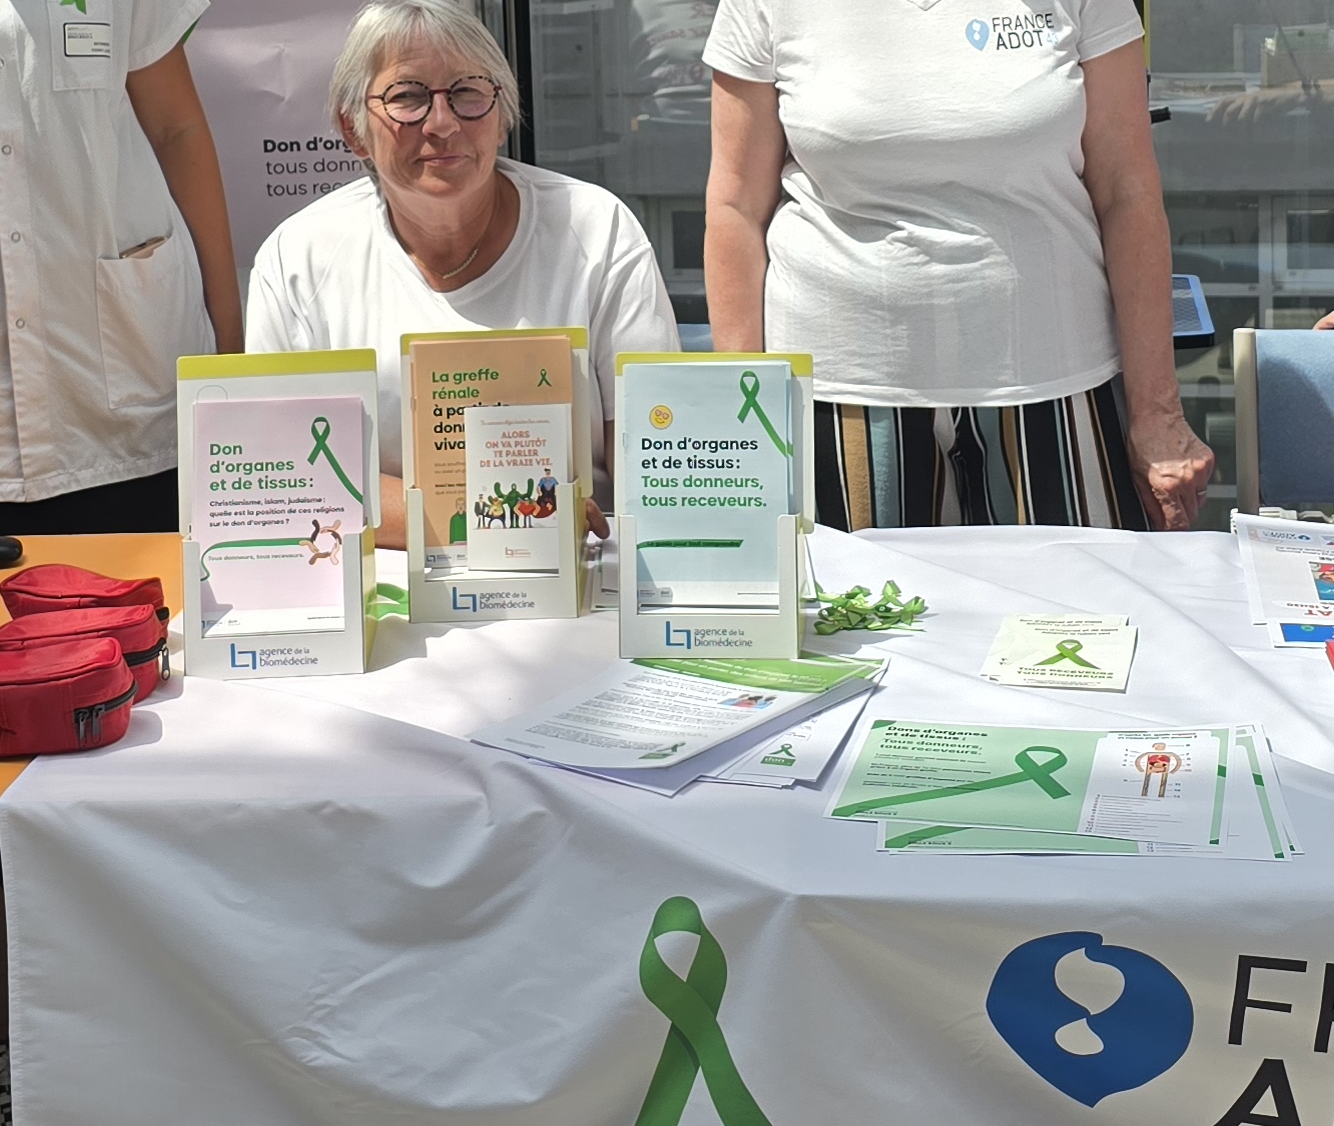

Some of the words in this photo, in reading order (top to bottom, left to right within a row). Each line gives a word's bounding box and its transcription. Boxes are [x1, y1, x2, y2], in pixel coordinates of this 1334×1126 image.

[991, 12, 1055, 33] FRANCE
[995, 29, 1044, 51] ADOT
[263, 138, 302, 153] Don
[266, 160, 308, 175] tous
[432, 371, 449, 384] La
[453, 368, 500, 385] greffe
[432, 386, 480, 400] rénale
[501, 430, 531, 439] ALORS
[209, 443, 243, 456] Don
[485, 440, 499, 449] ON
[500, 439, 513, 449] VA
[514, 437, 547, 448] PLUTÔT
[641, 437, 673, 451] Don
[677, 436, 759, 454] d'organes
[493, 450, 503, 458] TE
[505, 449, 539, 458] PARLER
[209, 459, 295, 476] d'organes
[479, 459, 491, 468] DE
[493, 459, 505, 467] LA
[506, 458, 534, 467] VRAIE
[641, 456, 658, 469] et
[662, 455, 683, 469] de
[209, 478, 227, 491] et
[231, 476, 253, 490] de
[641, 475, 679, 488] Tous
[682, 474, 764, 491] donneurs,
[641, 493, 678, 507] tous
[681, 495, 767, 508] receveurs.
[234, 509, 246, 517] est
[247, 508, 254, 516] la
[255, 506, 286, 517] position
[287, 507, 297, 515] de
[313, 505, 345, 515] religions
[694, 627, 728, 640] agence
[738, 628, 745, 636] la
[694, 636, 753, 647] biomédecine
[259, 647, 293, 659] agence
[294, 647, 303, 655] de
[259, 655, 318, 667] biomédecine
